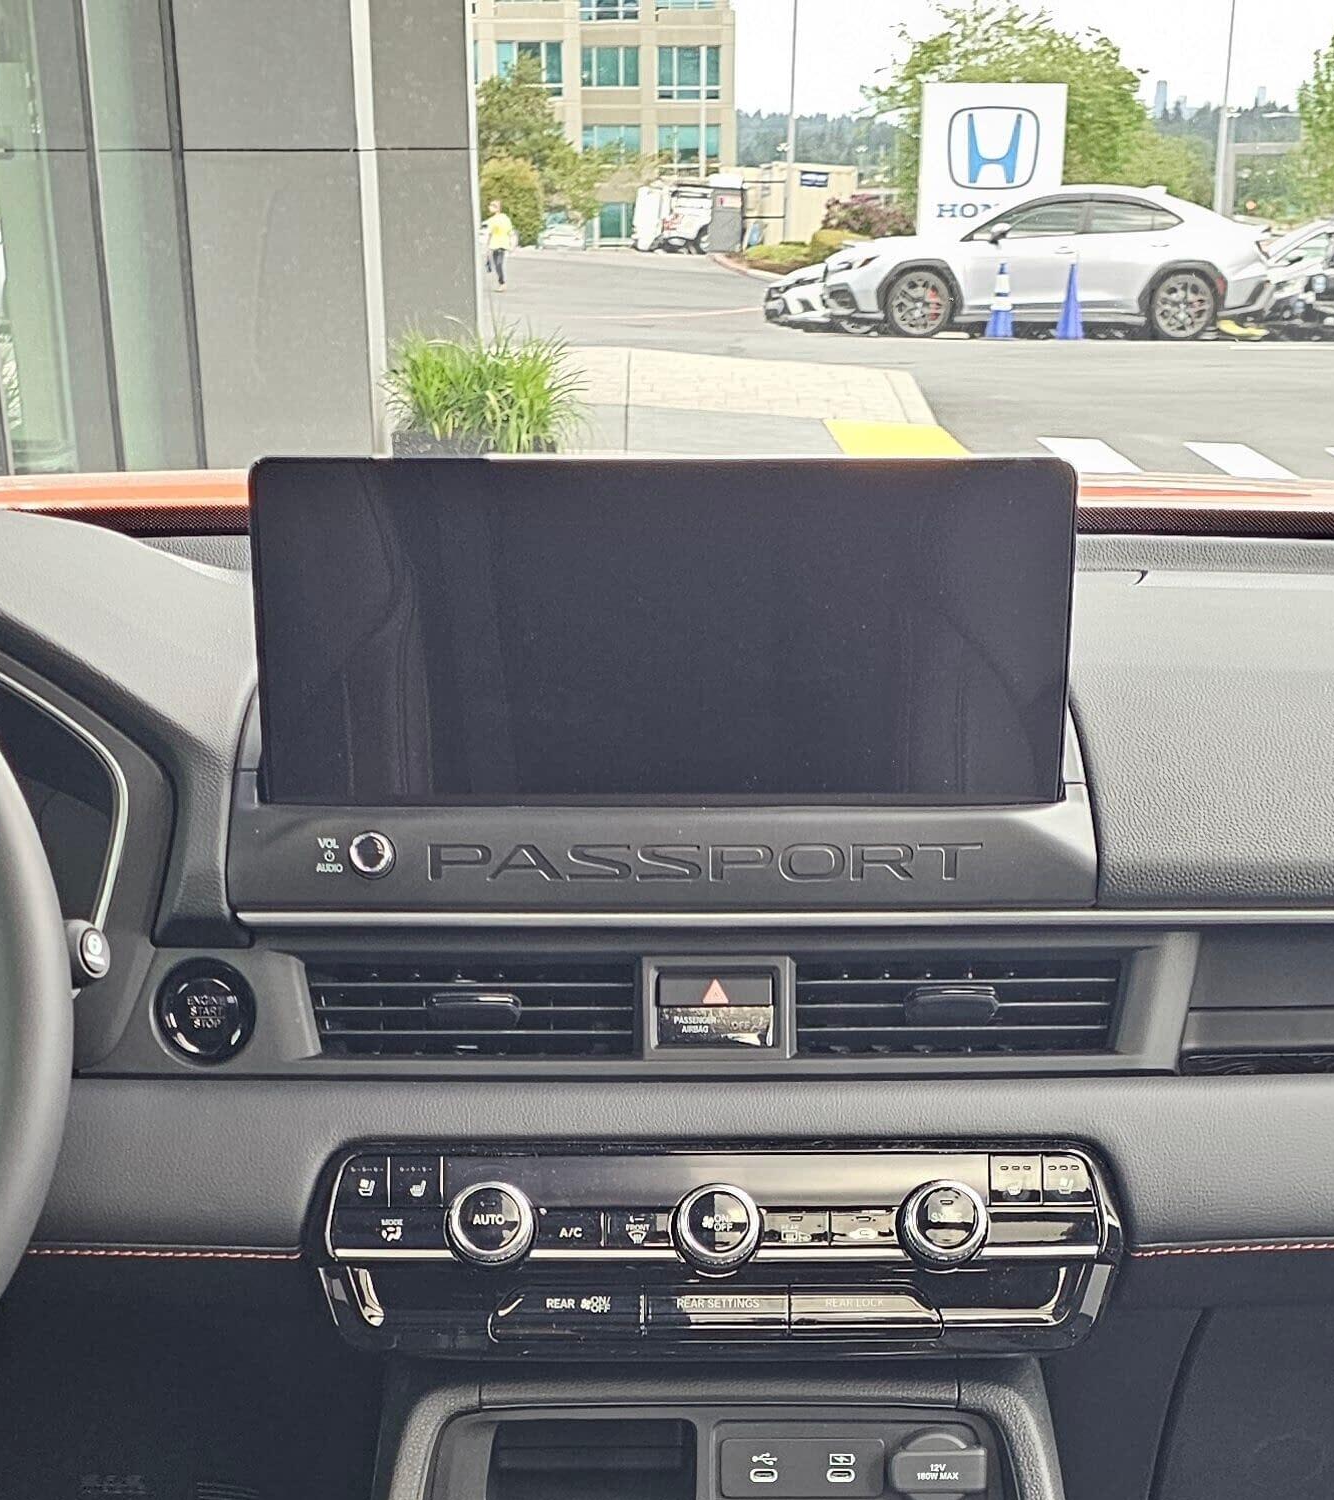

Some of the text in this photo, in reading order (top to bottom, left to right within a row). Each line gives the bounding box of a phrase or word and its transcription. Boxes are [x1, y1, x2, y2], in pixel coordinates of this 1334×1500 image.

[317, 837, 339, 848] VOL
[427, 842, 983, 883] PASSPORT
[316, 863, 344, 873] AUDIO
[674, 1016, 716, 1025] PASSENGER
[682, 1025, 709, 1034] AIRBAG
[472, 1214, 505, 1225] AUTO
[714, 1222, 734, 1231] OFF
[559, 1227, 583, 1239] A/C
[546, 1298, 575, 1309] REAR
[677, 1298, 760, 1309] REAR SETTINGS
[825, 1298, 884, 1308] REAR LOCK
[590, 1304, 611, 1313] OFF
[930, 1463, 946, 1472] 12V
[939, 1472, 959, 1480] MAX
